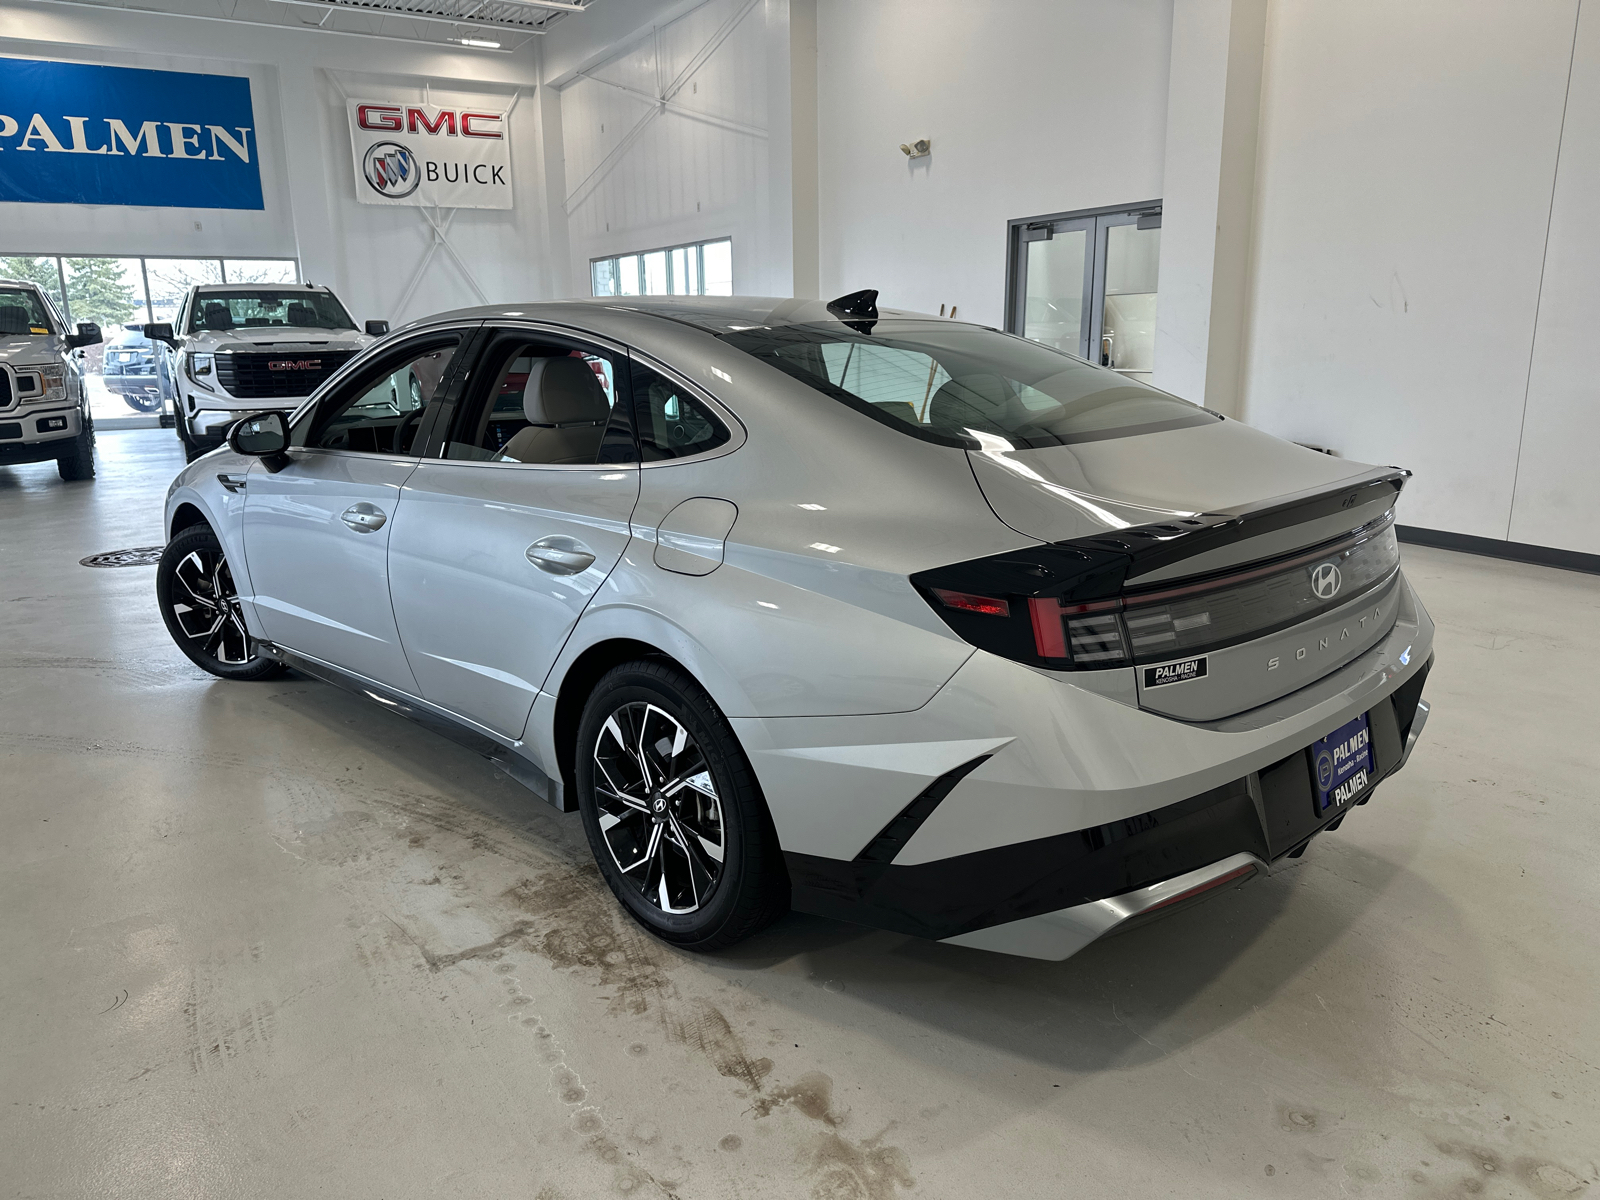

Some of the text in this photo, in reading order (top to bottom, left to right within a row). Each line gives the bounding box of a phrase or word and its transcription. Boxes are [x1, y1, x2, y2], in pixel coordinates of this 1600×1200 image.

[356, 103, 504, 141] GMC
[426, 161, 506, 186] BUICK
[268, 360, 321, 370] GMC
[1266, 607, 1381, 672] SONATA
[1155, 661, 1198, 678] PALMEN
[1333, 727, 1369, 765] PALMEN
[1334, 769, 1368, 806] PALMEN
